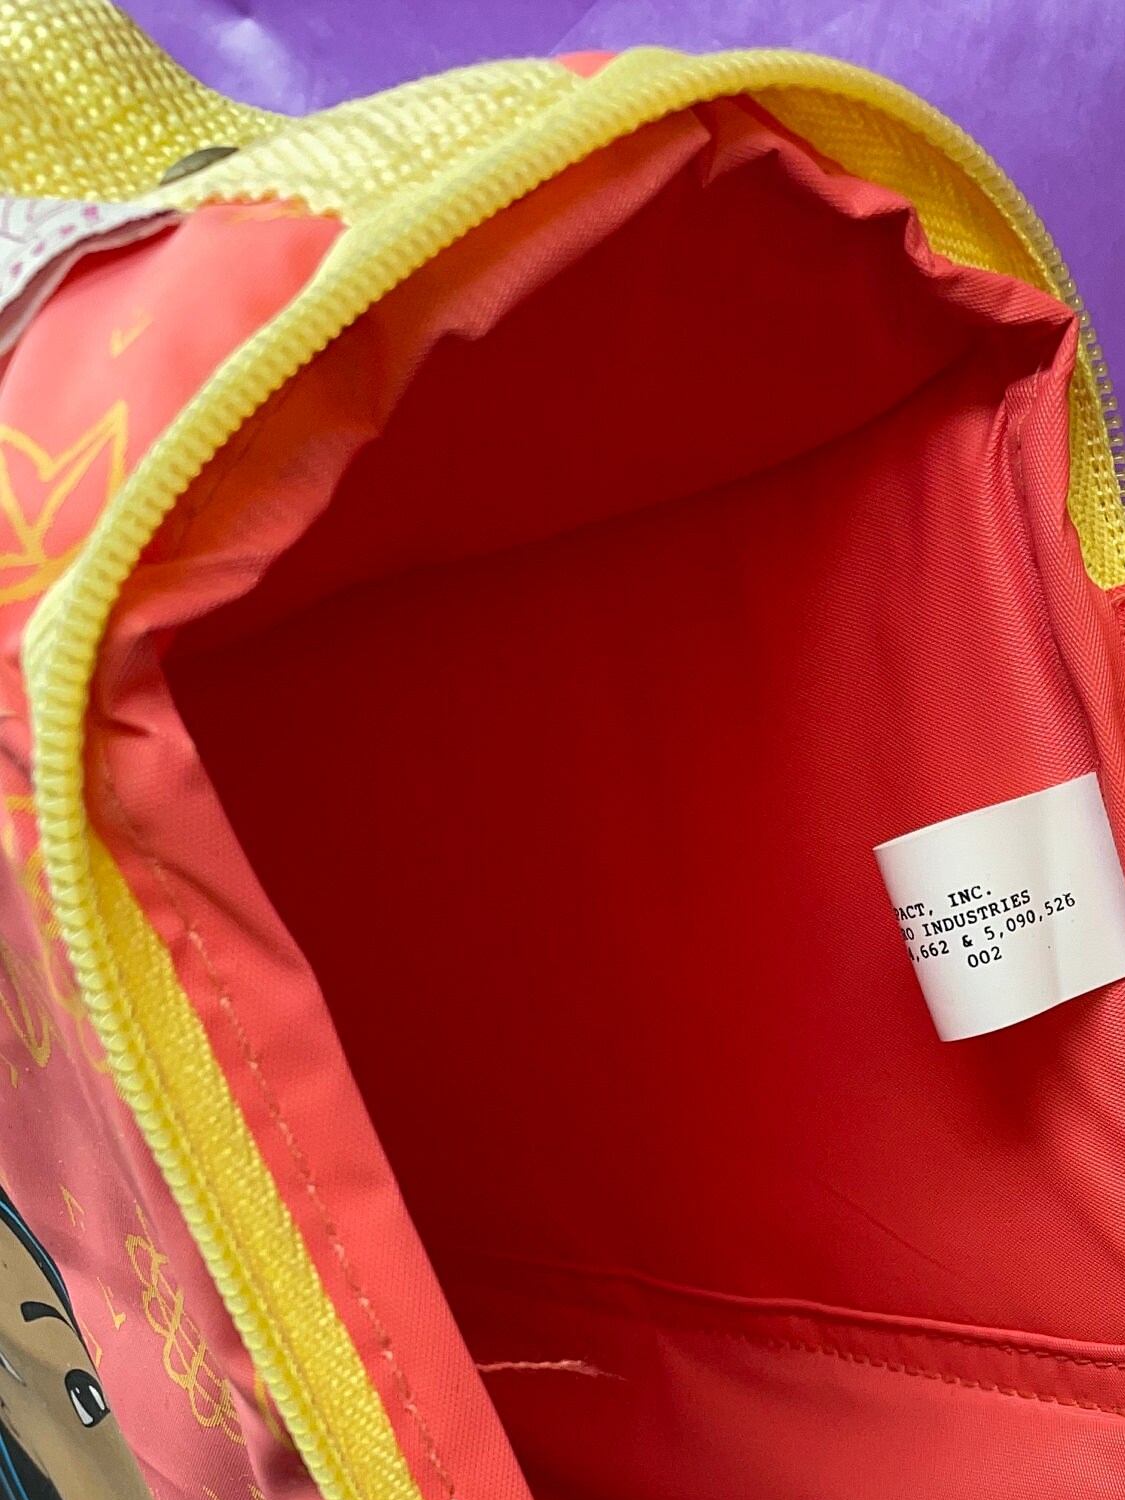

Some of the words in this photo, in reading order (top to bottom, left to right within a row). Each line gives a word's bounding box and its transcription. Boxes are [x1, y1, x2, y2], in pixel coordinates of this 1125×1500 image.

[922, 889, 1031, 937] INDUSTRIES
[947, 885, 992, 908] INC.
[962, 934, 973, 948] &
[984, 892, 1076, 941] 5,090,526
[967, 946, 1002, 968] 002
